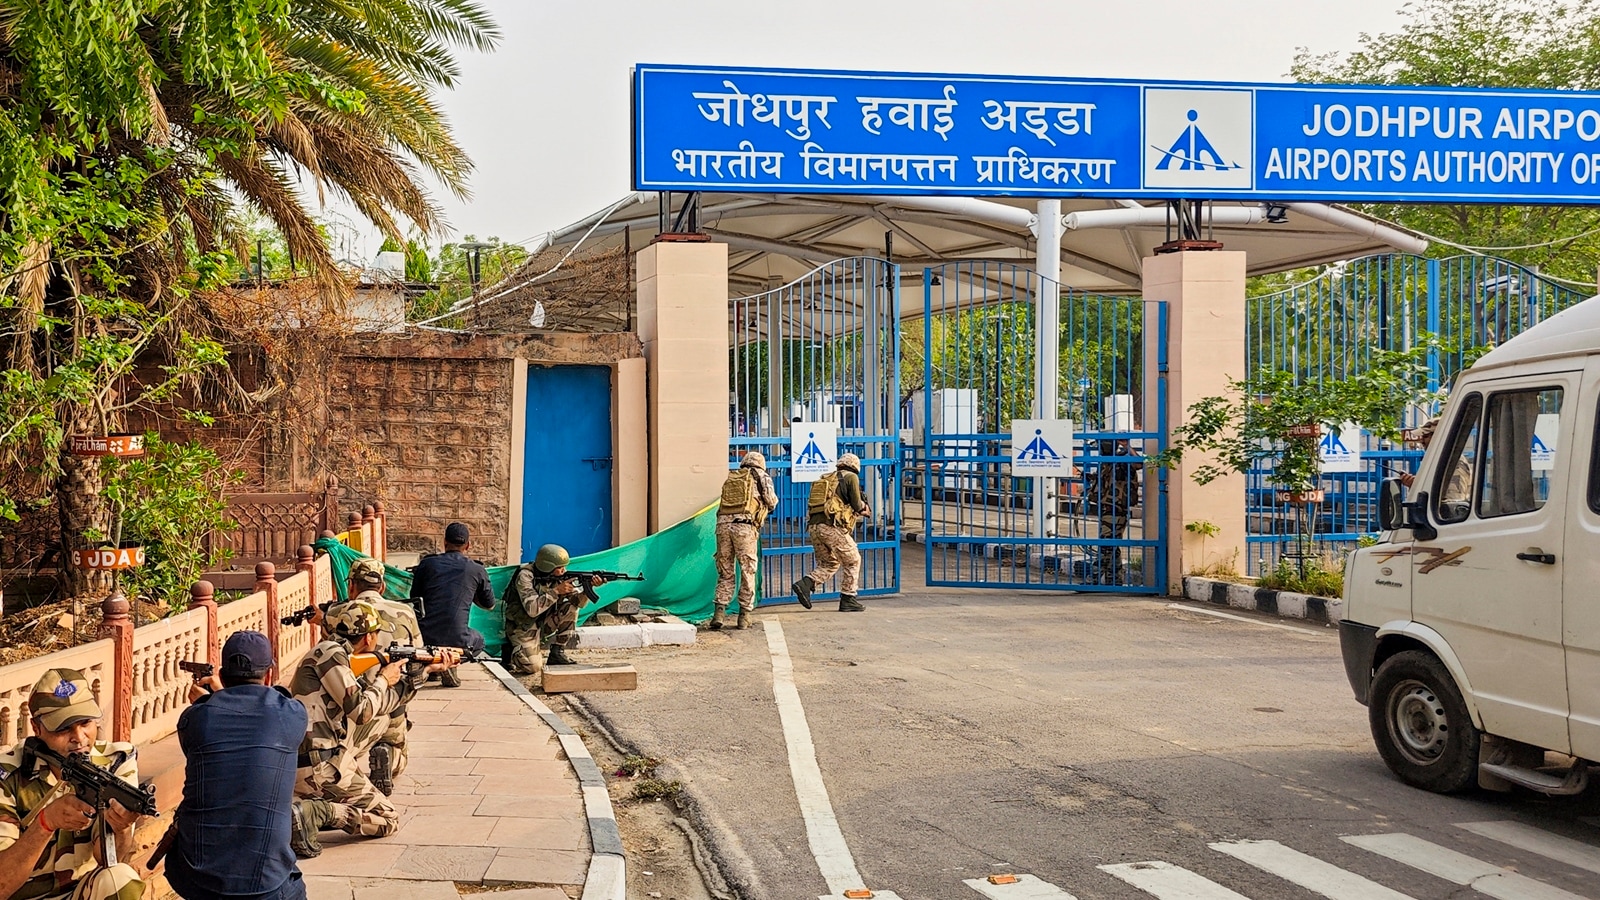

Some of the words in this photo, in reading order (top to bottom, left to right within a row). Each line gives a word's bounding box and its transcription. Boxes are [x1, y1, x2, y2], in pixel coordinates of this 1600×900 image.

[692, 80, 838, 141] जोधपुर
[855, 84, 959, 142] हवाई
[980, 99, 1098, 147] अड्डा
[1302, 104, 1484, 139] JODHPUR
[671, 140, 785, 179] भारतीय
[798, 141, 960, 182] विमानपत्तन
[972, 146, 1117, 185] प्राधिकरण
[1264, 147, 1407, 182] AIRPORTS
[1412, 150, 1565, 183] AUTHORITY
[87, 549, 131, 567] JDA
